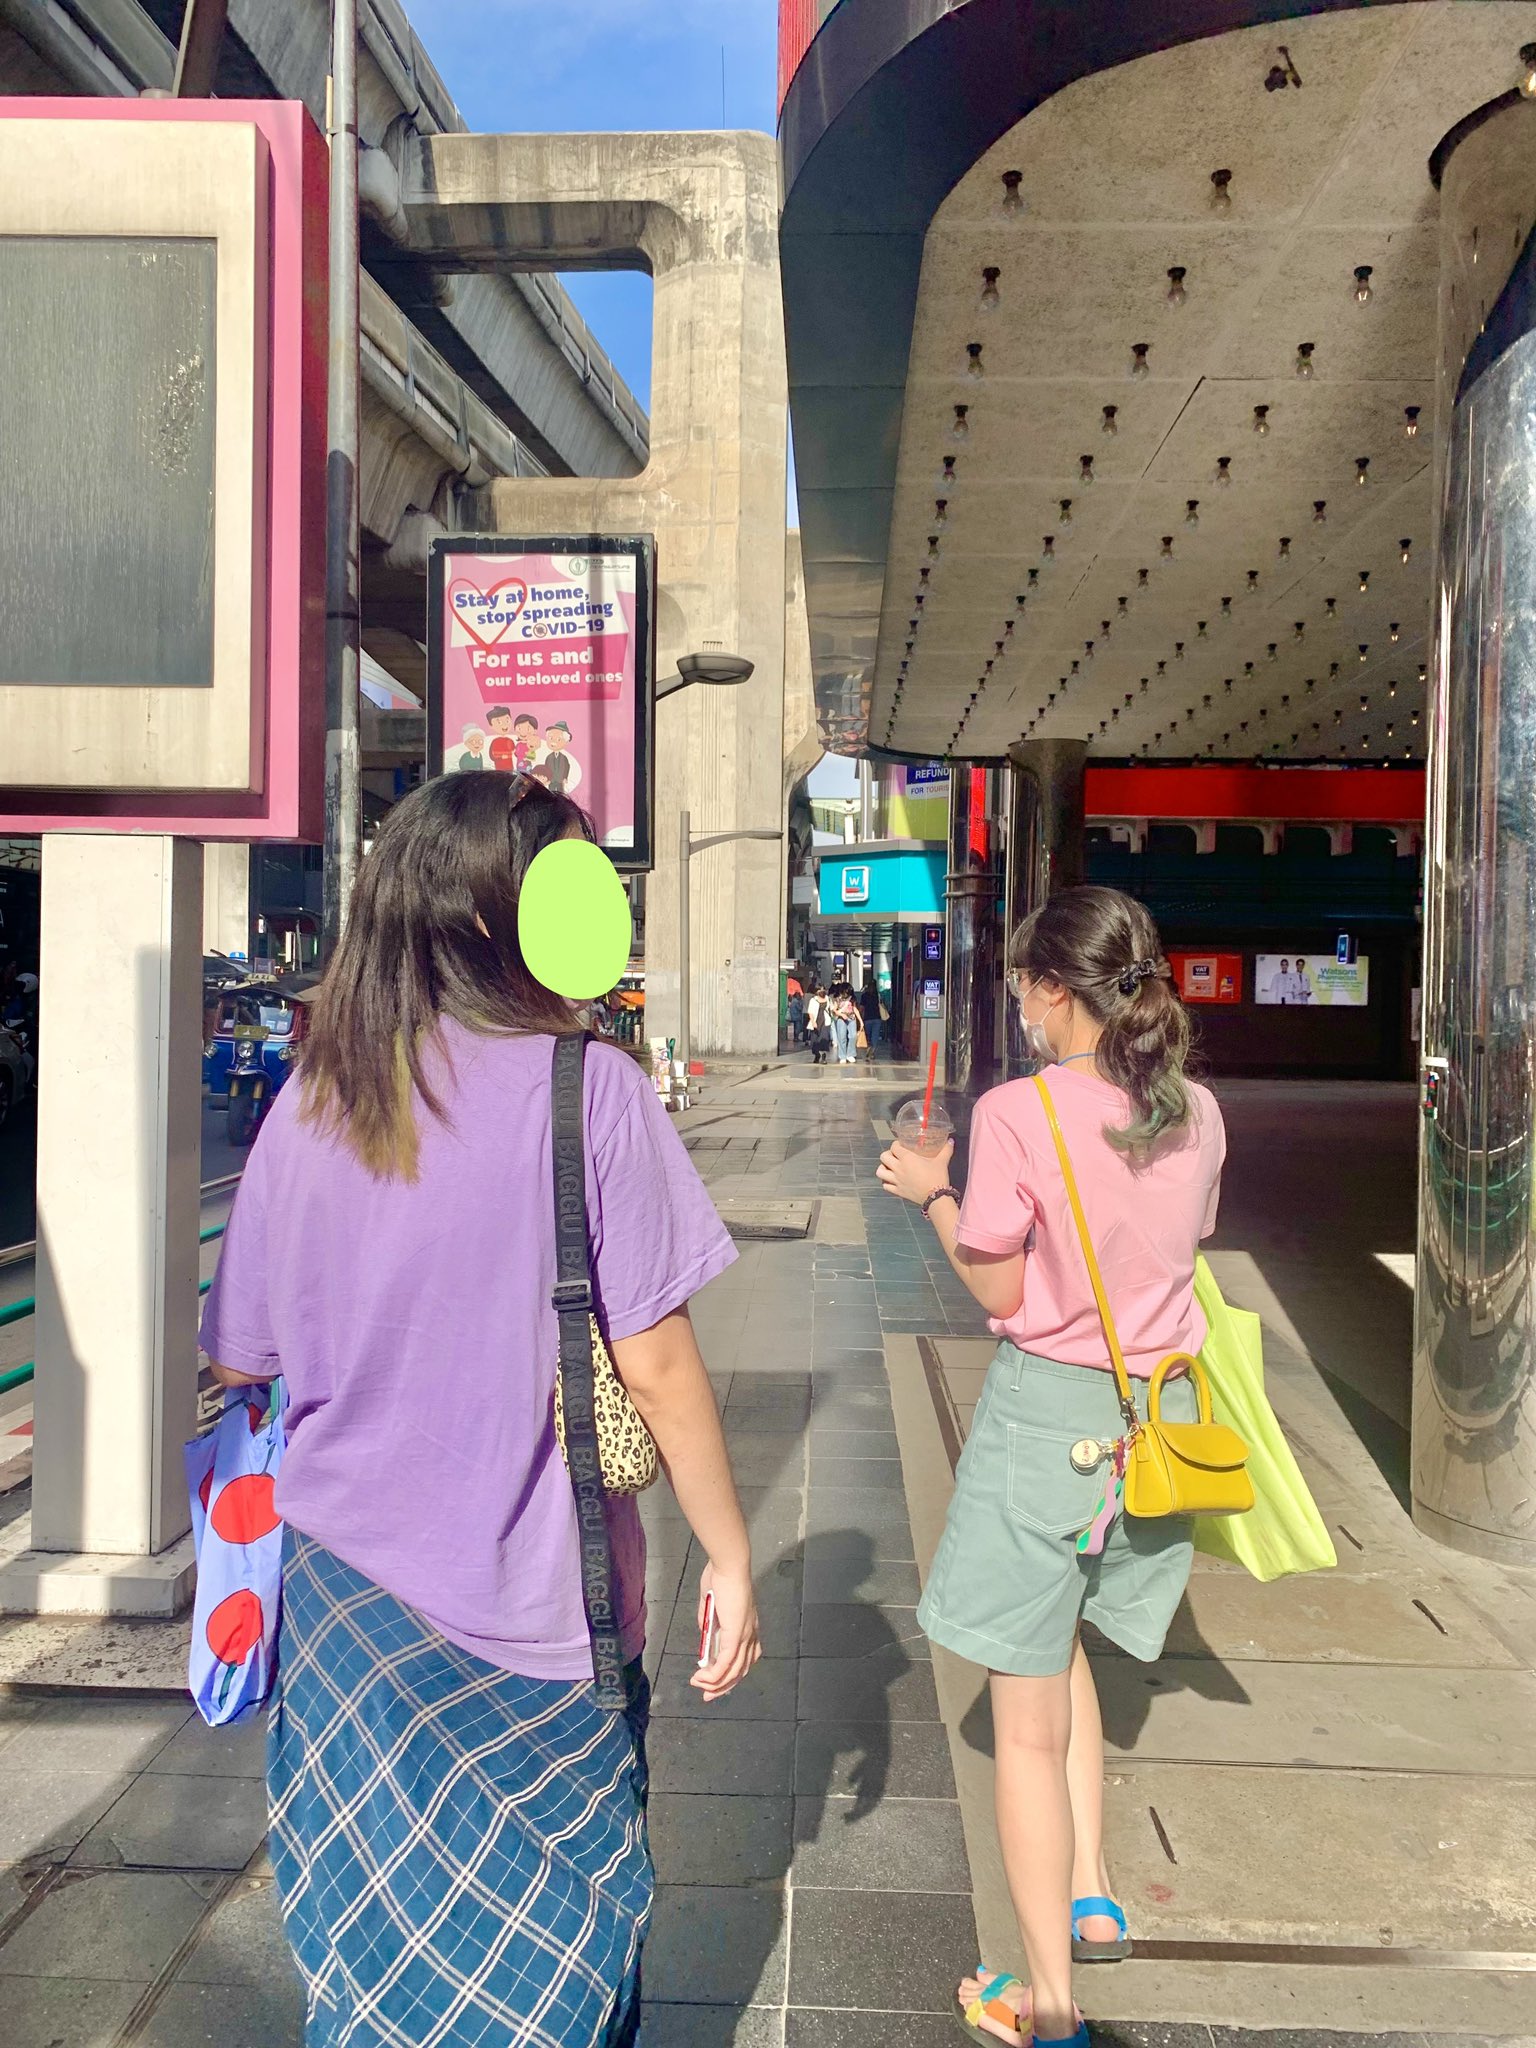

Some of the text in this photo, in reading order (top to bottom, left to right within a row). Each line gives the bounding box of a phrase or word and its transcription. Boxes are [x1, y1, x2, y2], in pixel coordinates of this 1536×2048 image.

[455, 586, 590, 609] Stay at home,
[477, 601, 613, 625] stop spreading
[472, 646, 593, 668] For us and
[485, 671, 623, 687] our beloved ones
[915, 768, 949, 779] REFUND
[911, 787, 924, 795] FOR
[849, 876, 860, 886] W
[558, 1039, 580, 1125] BAGGU
[557, 1138, 583, 1233] BAGGU
[560, 1245, 585, 1327] BAU
[565, 1339, 592, 1434] BAGGU
[571, 1446, 604, 1531] BAGGU
[585, 1543, 614, 1629] BAGGU
